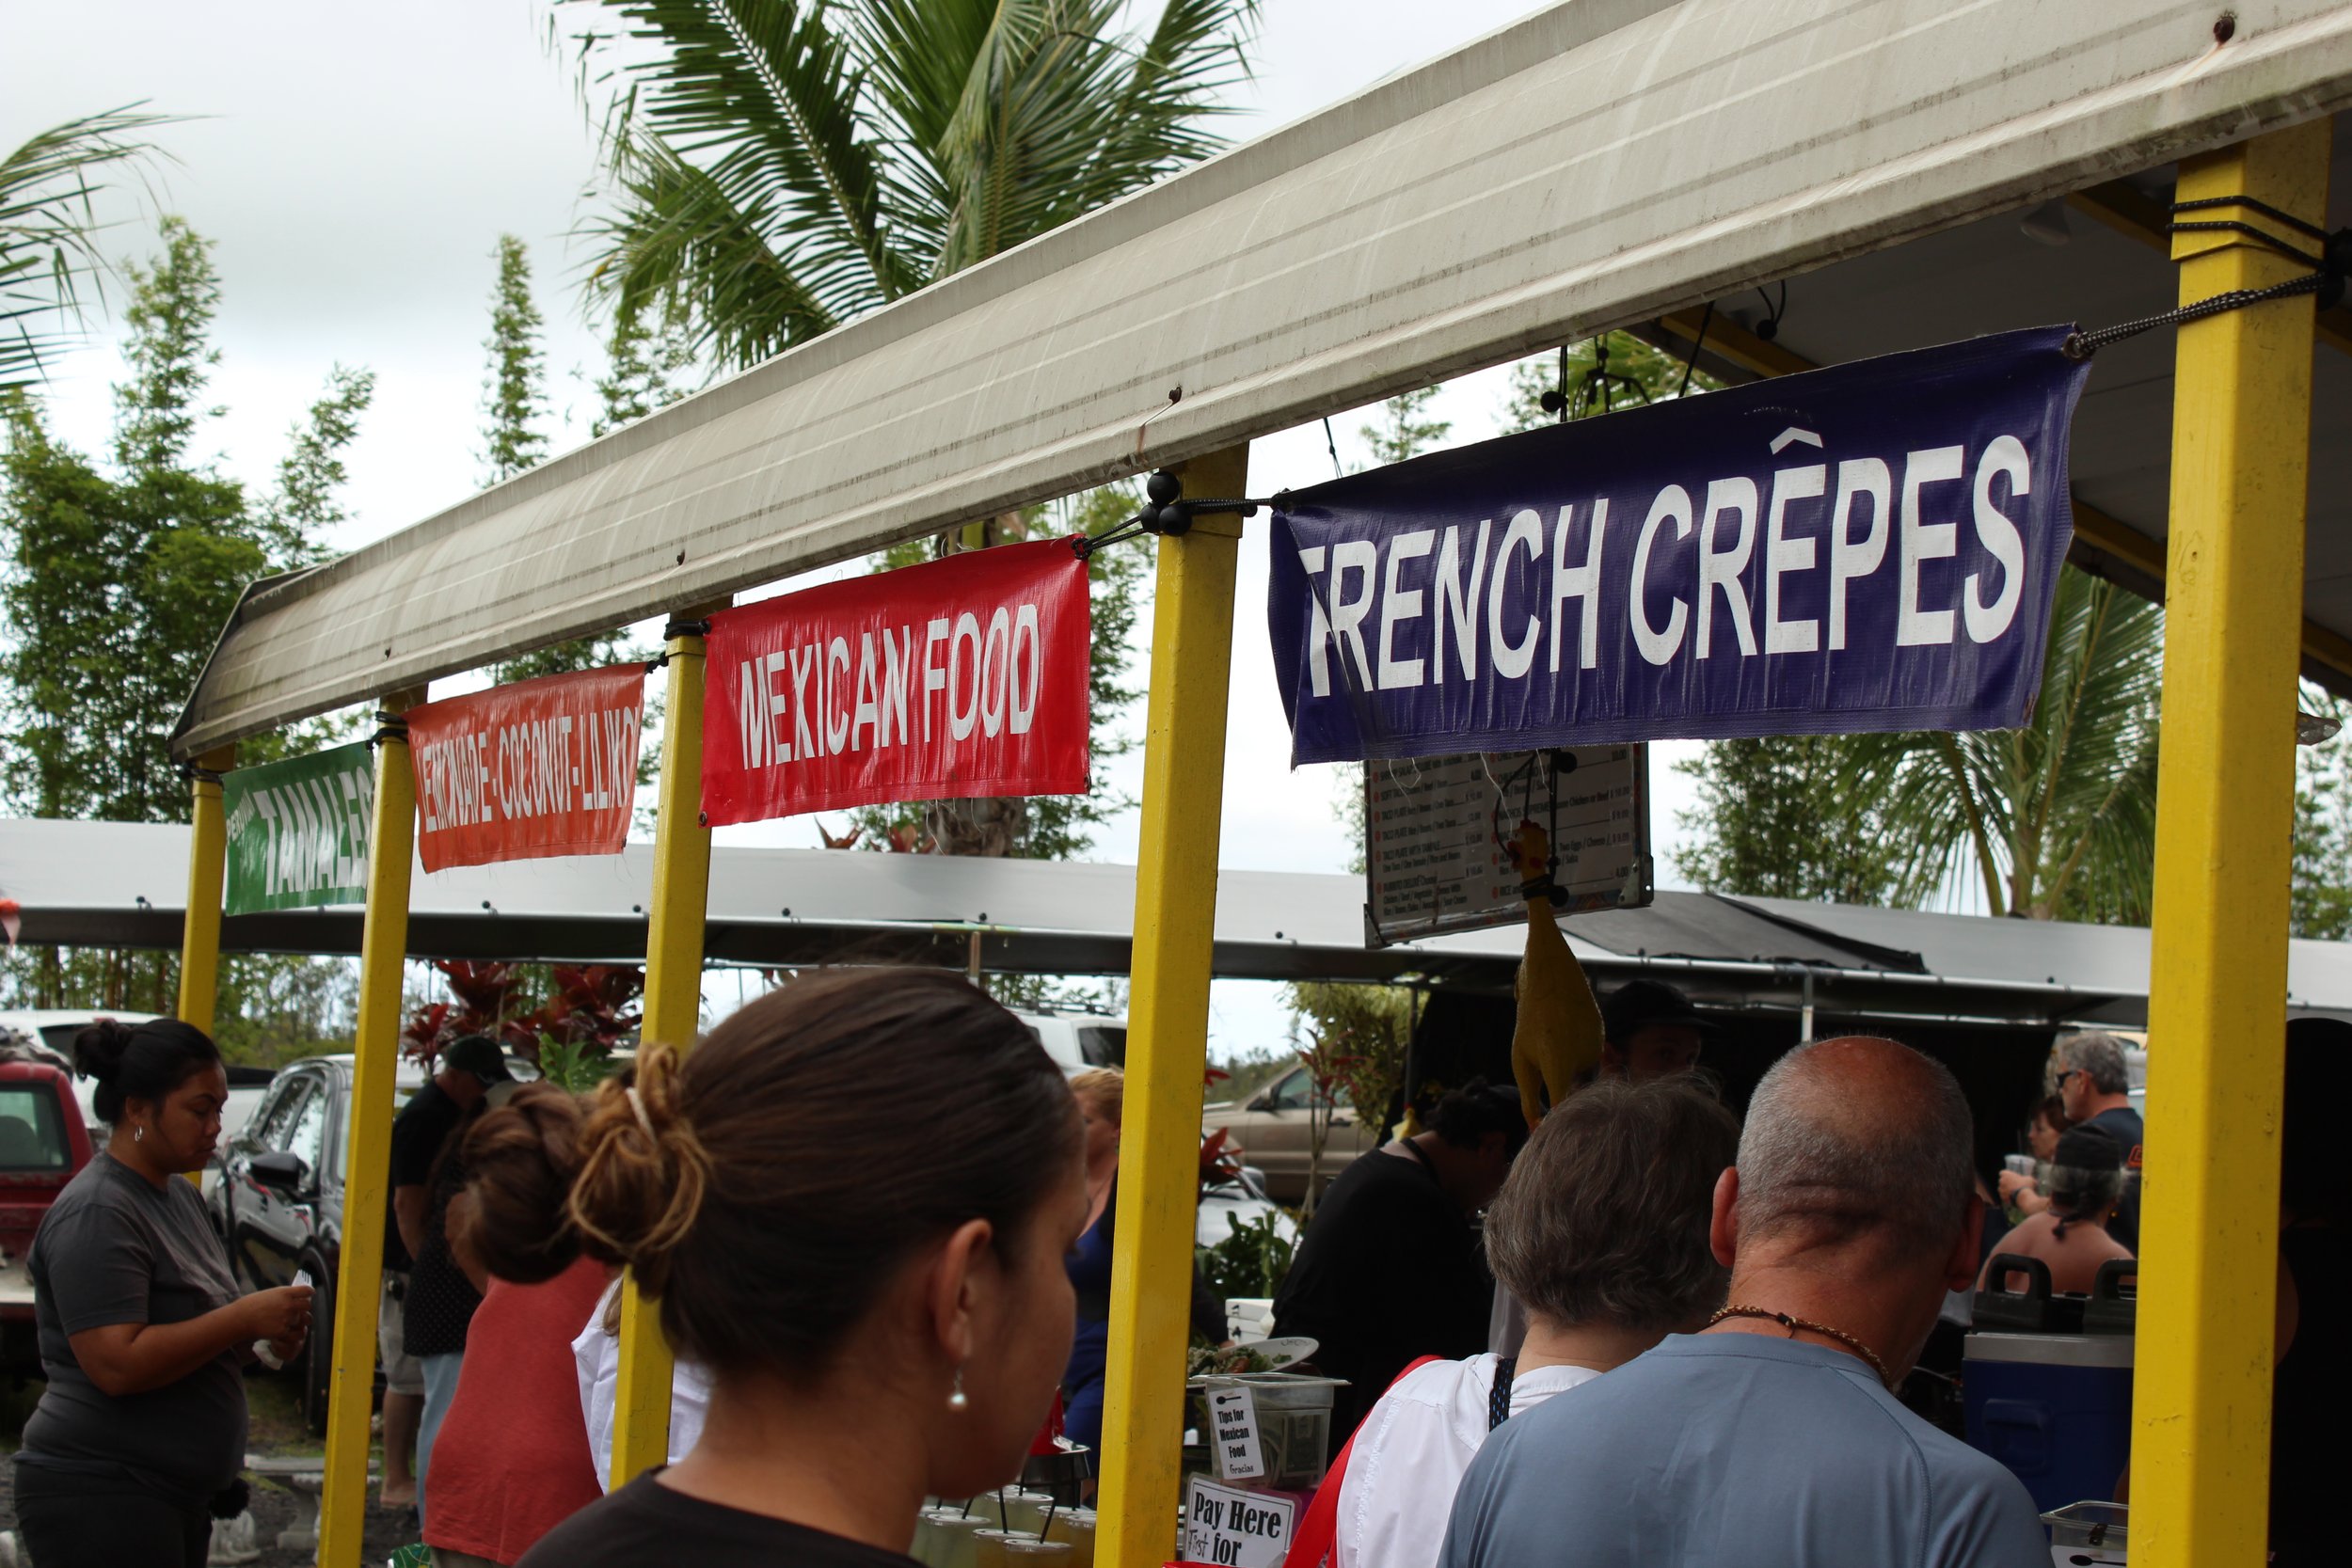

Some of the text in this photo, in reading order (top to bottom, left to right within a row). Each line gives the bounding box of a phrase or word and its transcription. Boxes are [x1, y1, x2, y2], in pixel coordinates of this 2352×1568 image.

[1297, 426, 2031, 698] FRENCH CRÊPES
[740, 604, 1040, 770] MEXICAN FOOD
[252, 766, 372, 896] TAMALES
[1217, 1409, 1244, 1424] Tips for
[1219, 1427, 1249, 1442] Mexican
[1229, 1444, 1246, 1458] Food
[1230, 1464, 1254, 1474] Gracias
[1193, 1492, 1281, 1539] Pay Here
[1212, 1532, 1242, 1566] for
